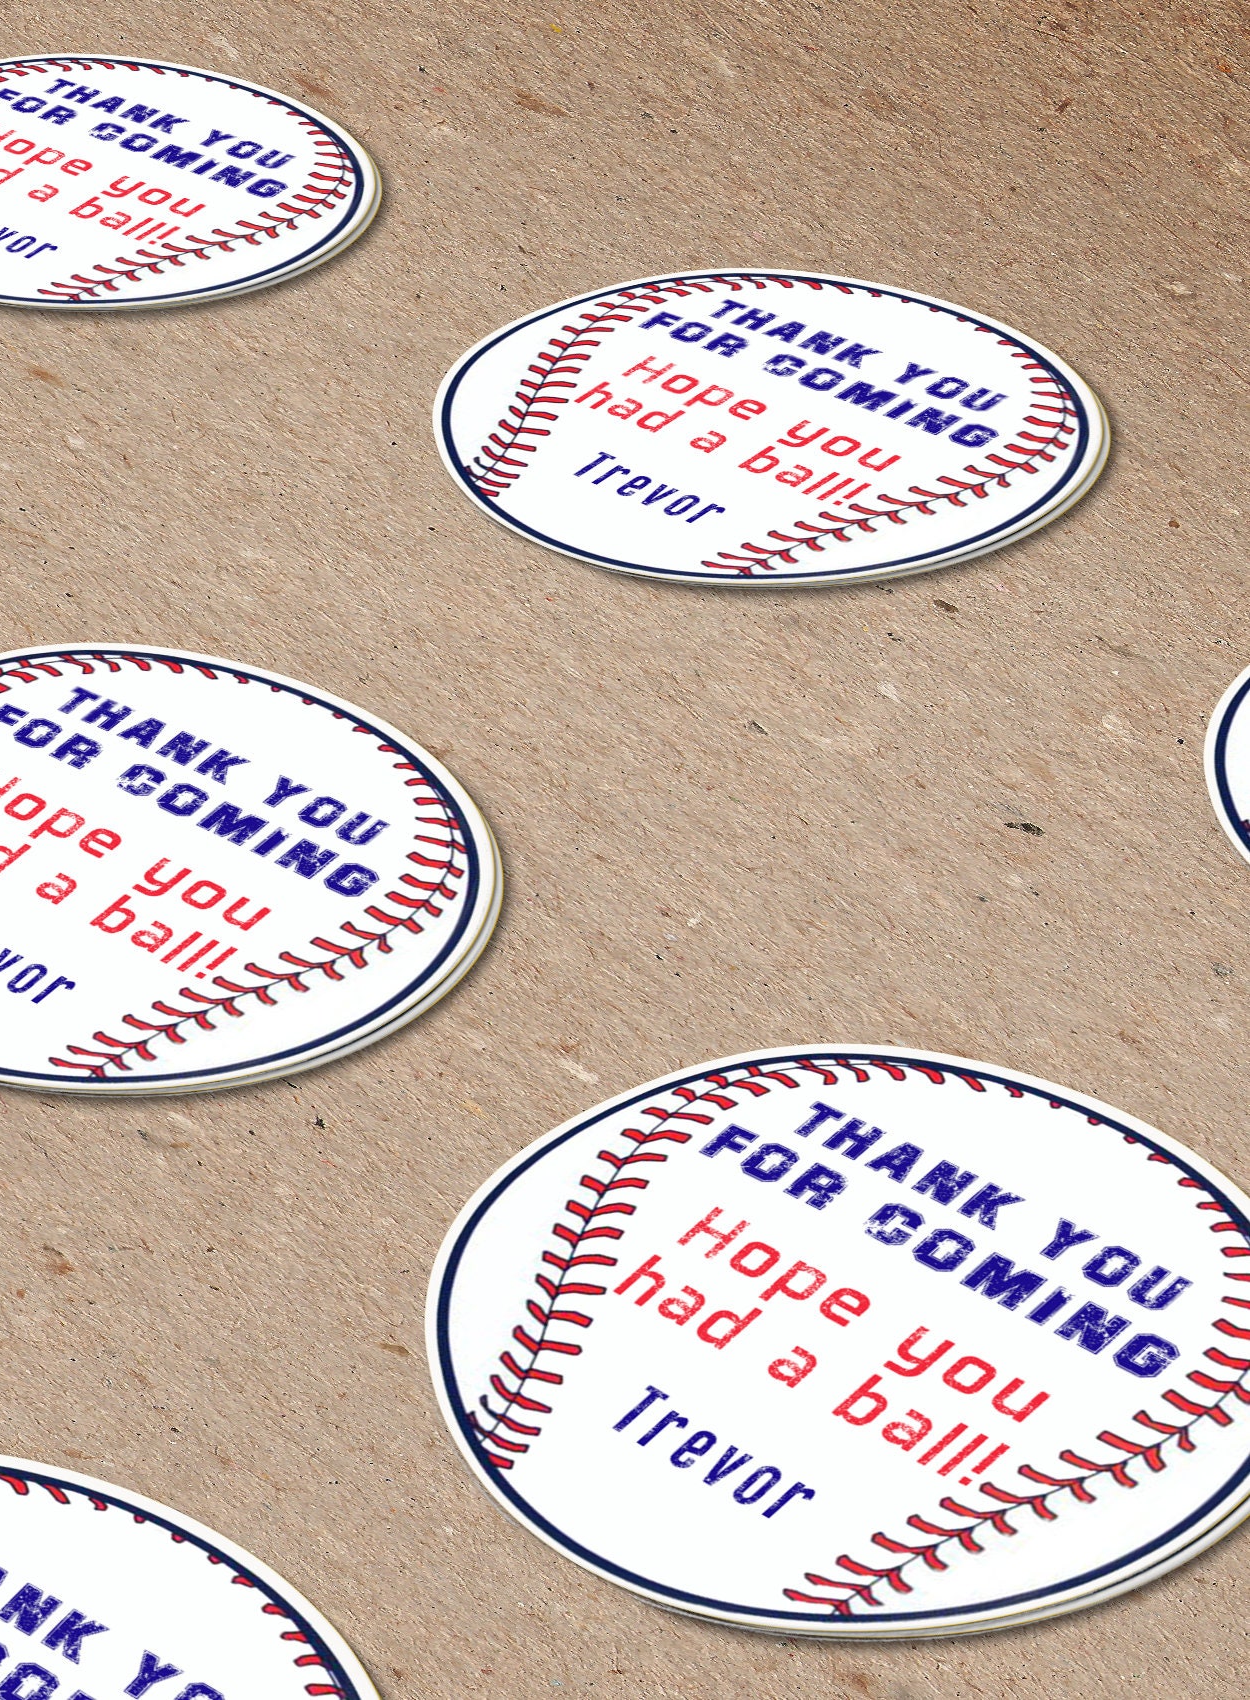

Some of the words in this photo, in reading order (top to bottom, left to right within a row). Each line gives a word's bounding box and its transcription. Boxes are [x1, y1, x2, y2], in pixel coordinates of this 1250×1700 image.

[47, 78, 188, 134] THANK
[201, 130, 294, 168] YOU
[87, 123, 287, 198] COMING
[28, 184, 59, 202] a
[69, 196, 180, 245] ball!
[101, 176, 205, 217] you
[622, 356, 767, 420] Hope
[777, 420, 901, 472] you
[640, 312, 747, 357] FOR
[763, 354, 998, 447] COMING
[712, 300, 879, 368] THANK
[895, 363, 1006, 411] YOU
[575, 381, 685, 432] had
[690, 431, 727, 453] a
[739, 446, 871, 506] ball!
[575, 452, 725, 523] Trevor
[59, 687, 248, 784] THANK
[264, 777, 388, 845] YOU
[118, 765, 378, 897] COMING
[36, 873, 77, 905] a
[90, 894, 238, 979] ball!
[132, 858, 271, 931] you
[701, 1125, 845, 1210] FOR
[866, 1204, 1180, 1378] COMING
[796, 1102, 1022, 1229] THANK
[1041, 1220, 1191, 1310] YOU
[614, 1254, 762, 1350] had
[768, 1346, 817, 1388] a
[833, 1374, 1010, 1486] ball!
[678, 1207, 870, 1327] Hope
[883, 1326, 1050, 1423] you
[613, 1386, 815, 1518] Trevor
